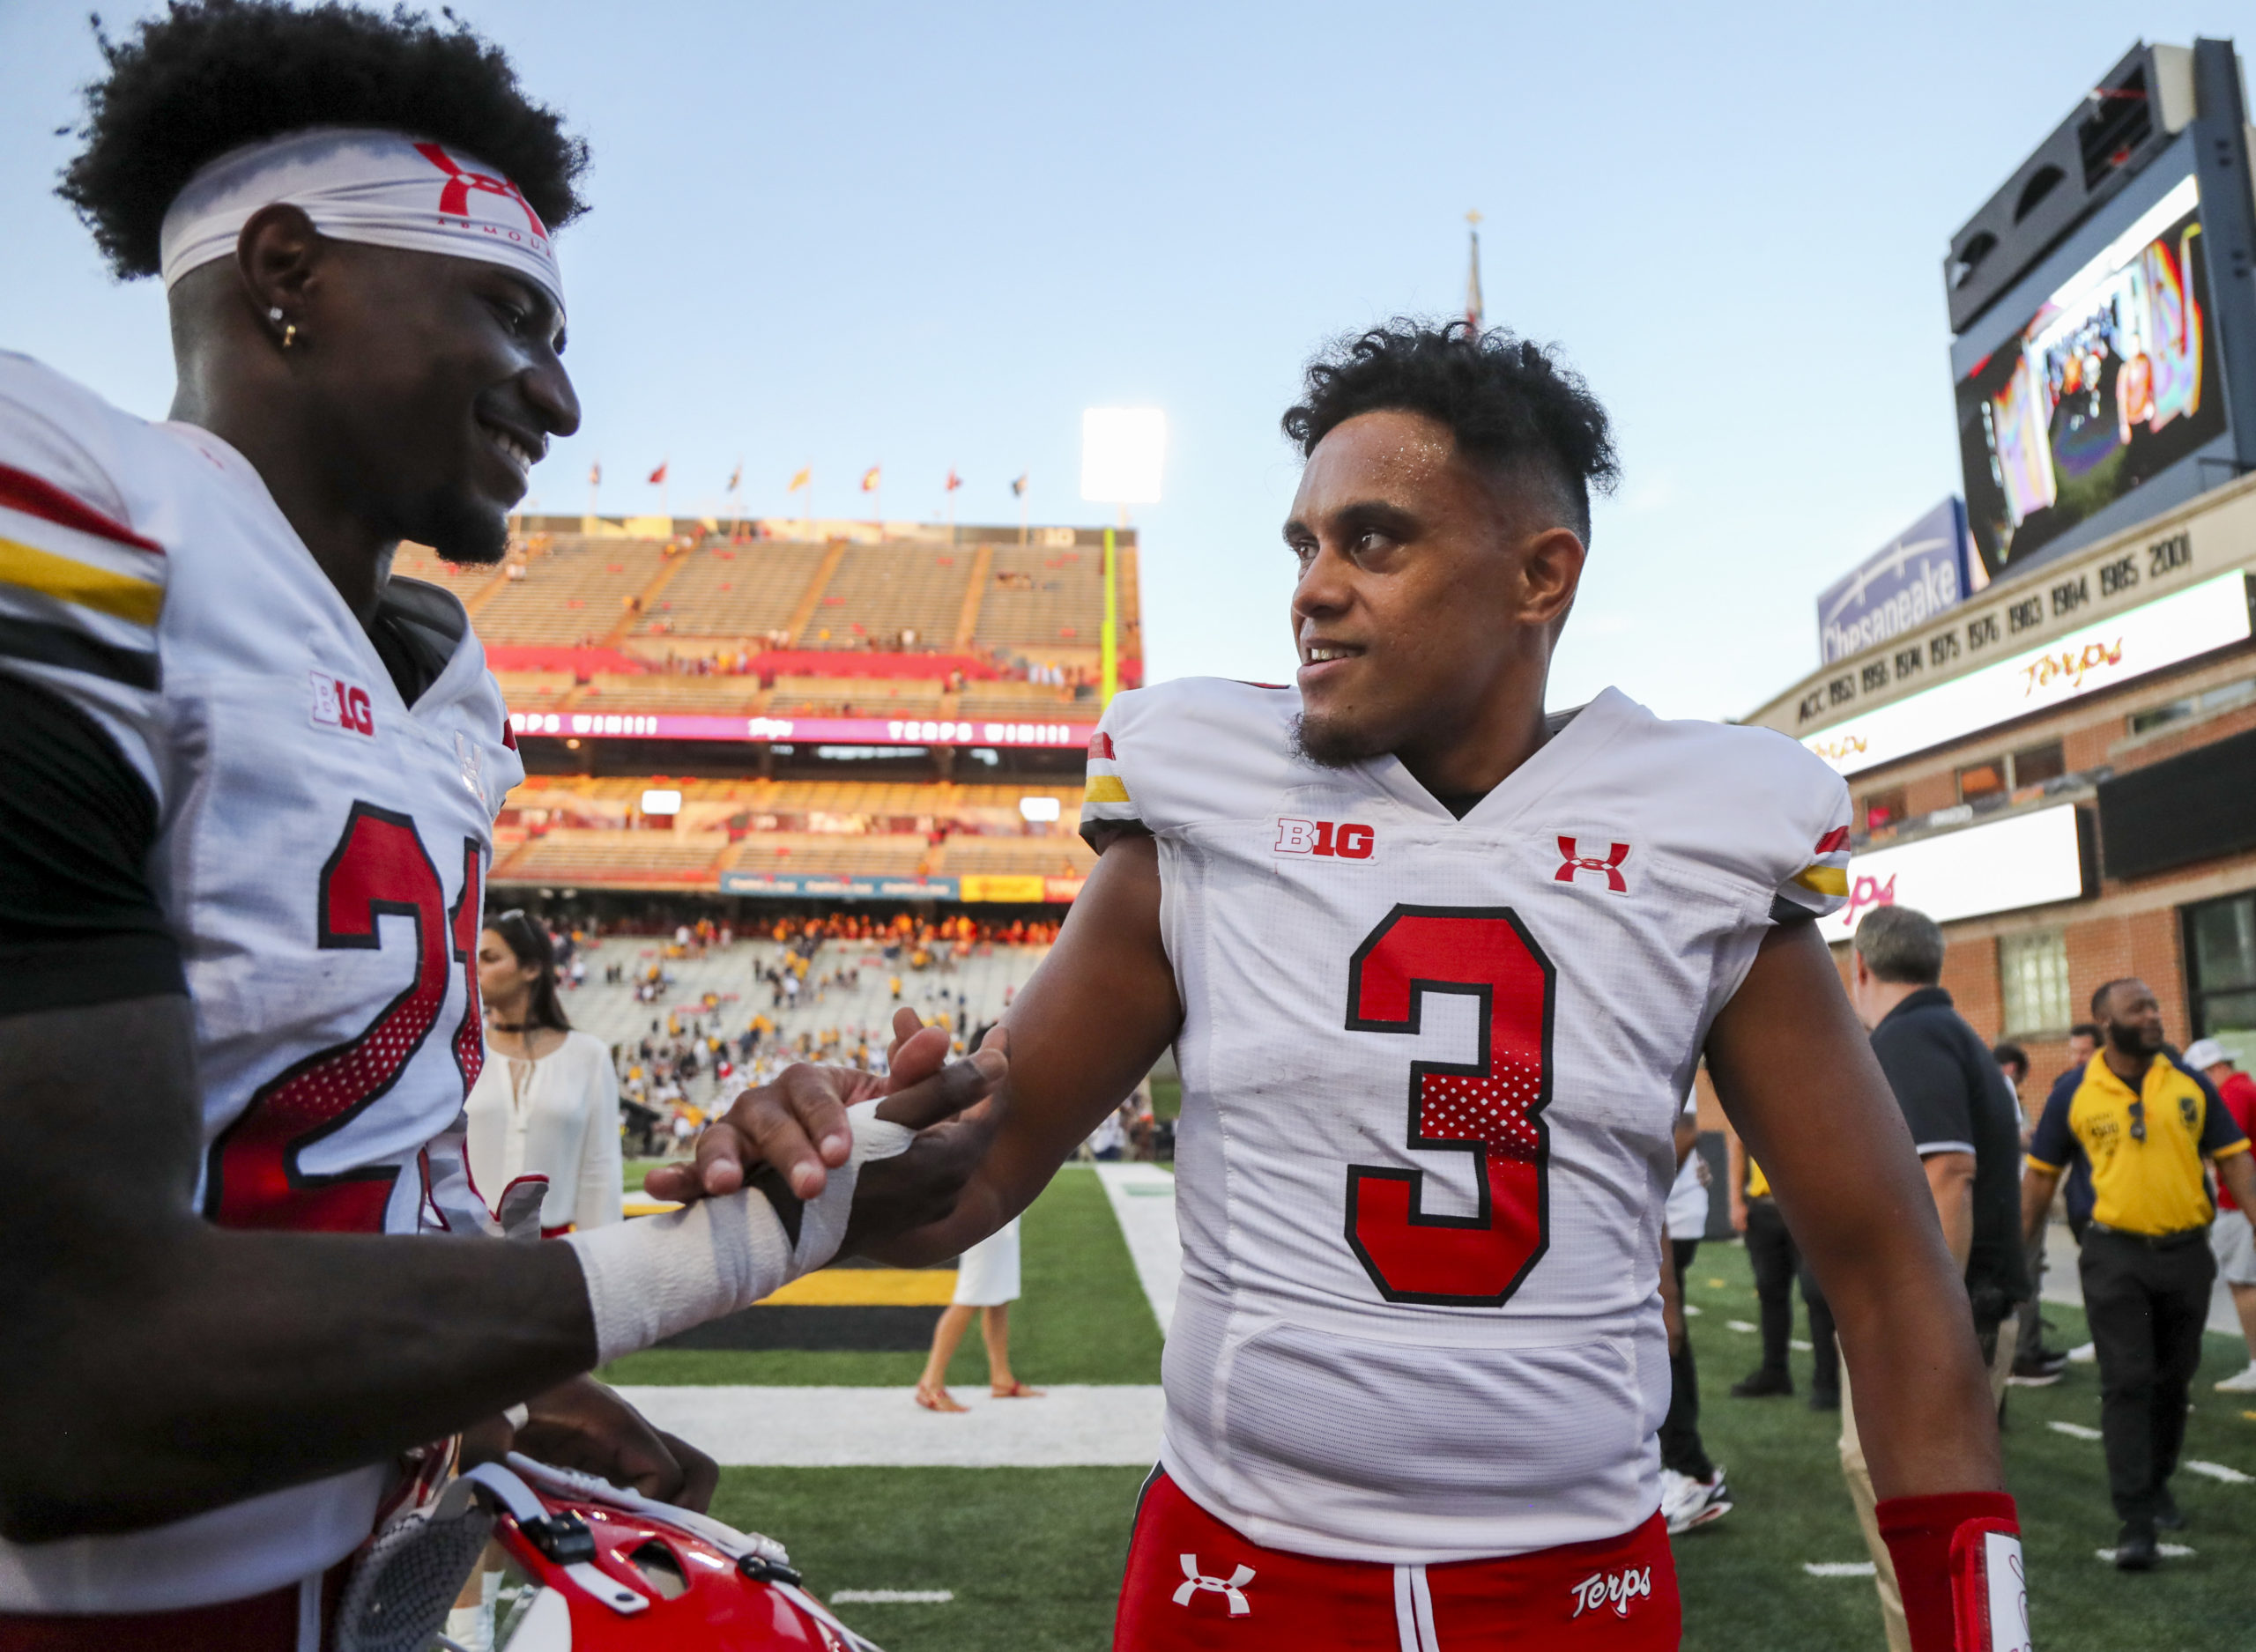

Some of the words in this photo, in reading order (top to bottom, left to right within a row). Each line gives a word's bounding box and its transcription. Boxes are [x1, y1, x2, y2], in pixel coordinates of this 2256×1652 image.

[1799, 687, 1828, 724] ACC
[1930, 629, 1961, 667] 1975
[1968, 614, 2001, 651] 1976
[2009, 594, 2044, 635] 1983
[2052, 574, 2089, 617] 1984
[2100, 551, 2141, 598] 1985
[2148, 527, 2193, 579] 2001
[1344, 902, 1557, 1308] 3
[1570, 1566, 1651, 1619] Terps
